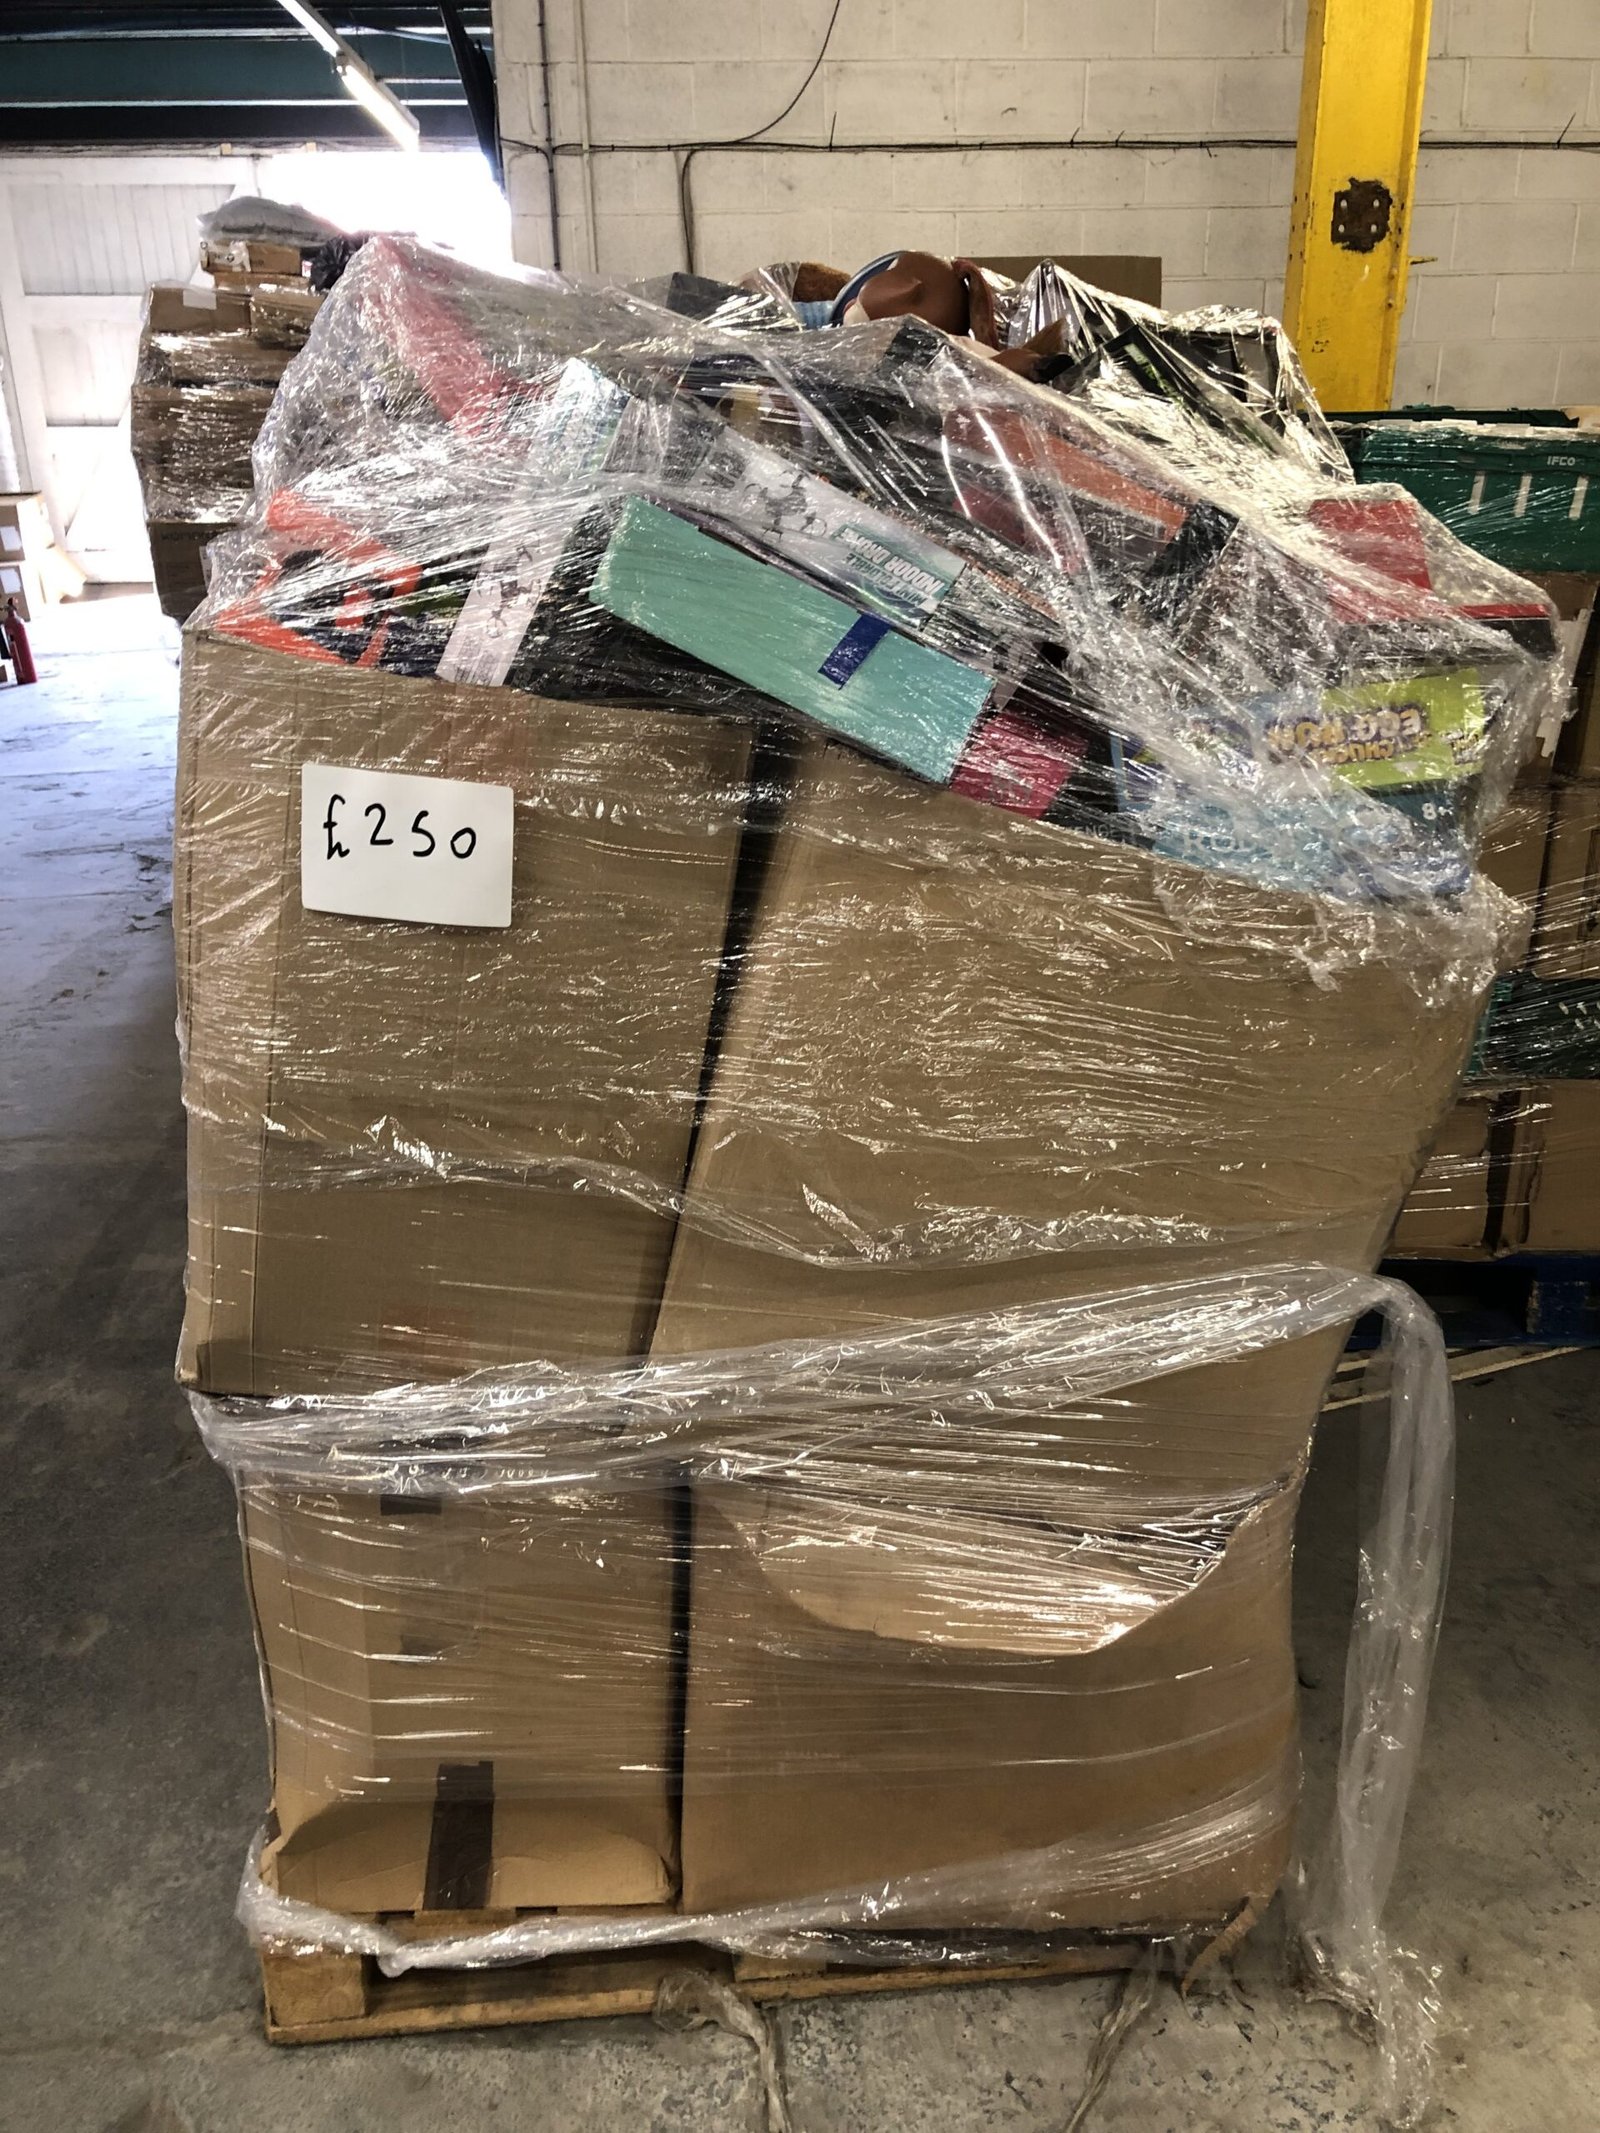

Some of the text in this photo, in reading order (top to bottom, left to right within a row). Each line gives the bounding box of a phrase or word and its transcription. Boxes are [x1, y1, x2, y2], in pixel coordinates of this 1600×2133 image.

[1547, 455, 1576, 466] IFCO
[841, 527, 945, 596] INDOOR DRONE
[1352, 708, 1422, 742] EGG
[323, 793, 477, 860] £250
